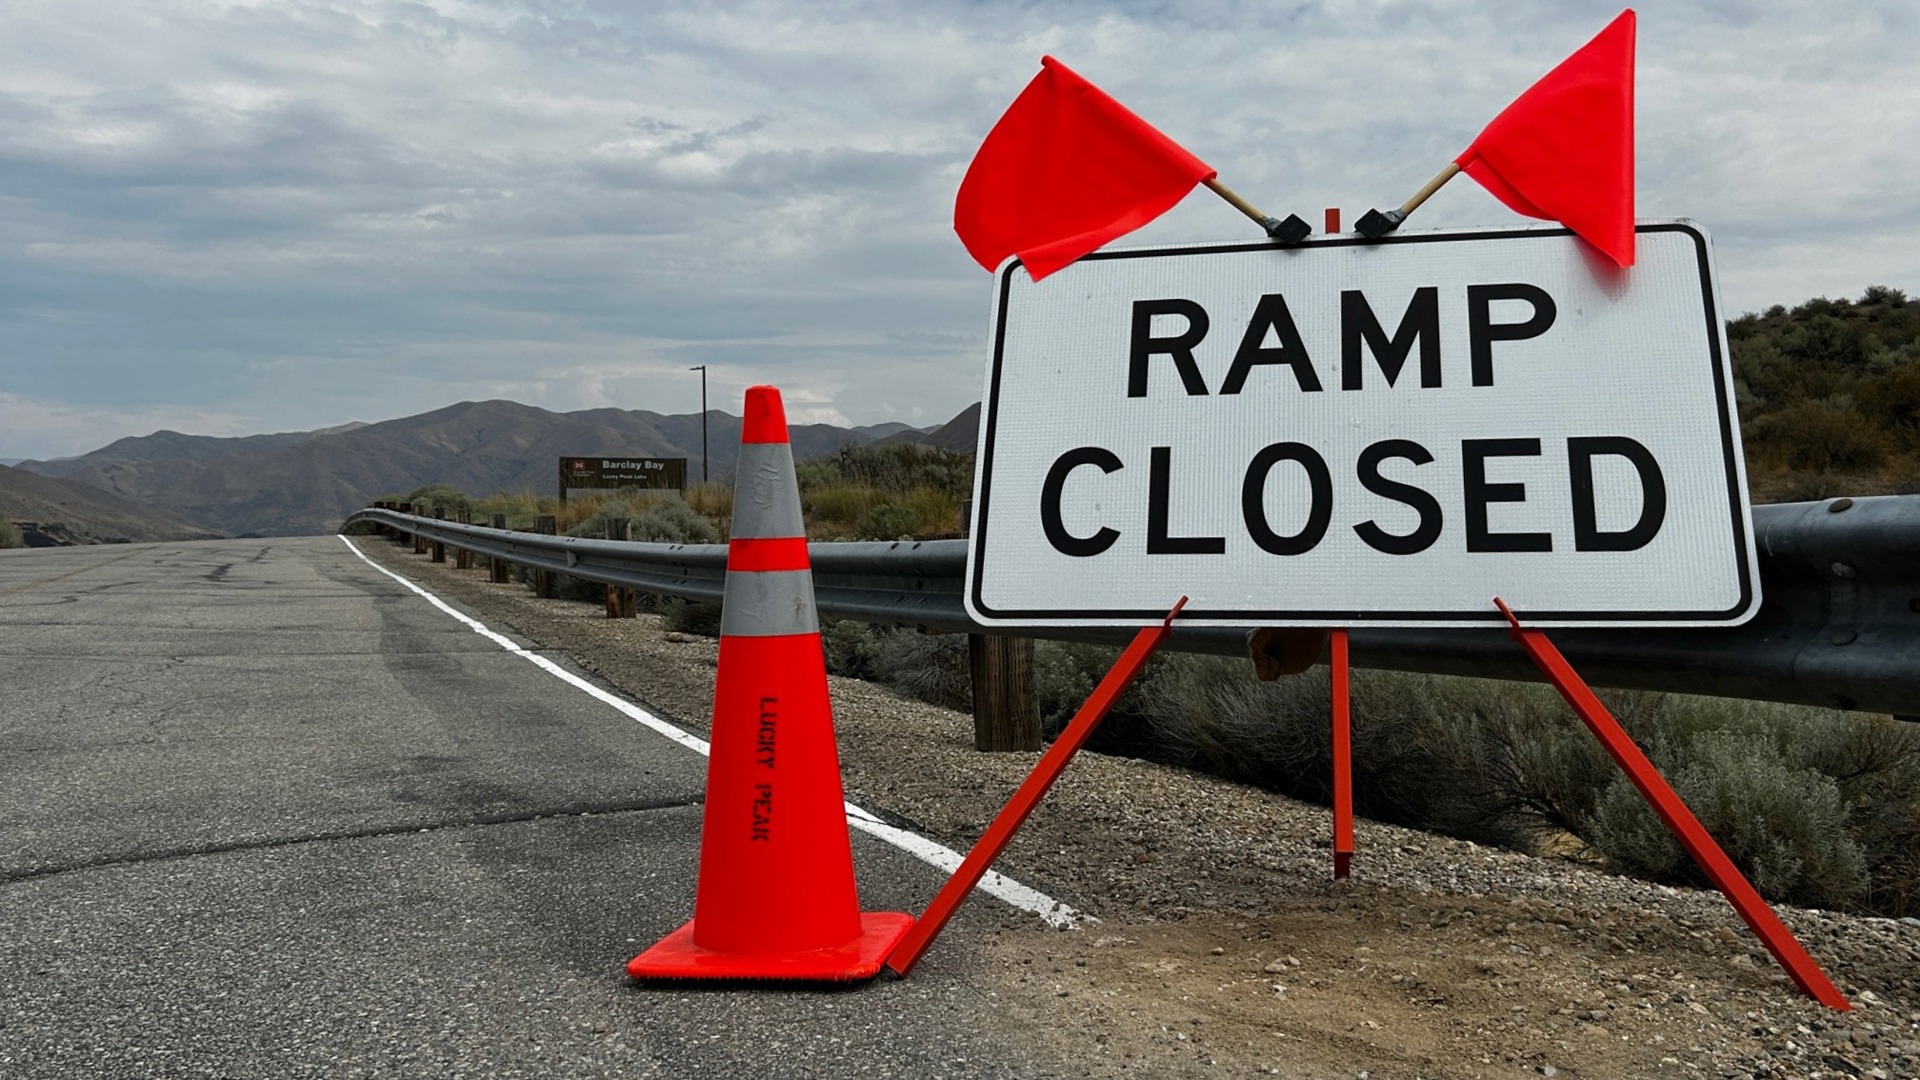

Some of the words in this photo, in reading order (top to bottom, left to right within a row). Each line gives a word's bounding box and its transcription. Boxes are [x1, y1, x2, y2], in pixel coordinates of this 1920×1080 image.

[1128, 283, 1557, 398] RAMP
[602, 460, 642, 471] Barclay
[644, 460, 664, 471] Bay
[1040, 436, 1667, 558] CLOSED
[757, 697, 779, 769] LUCKY
[751, 783, 773, 842] PEAK
